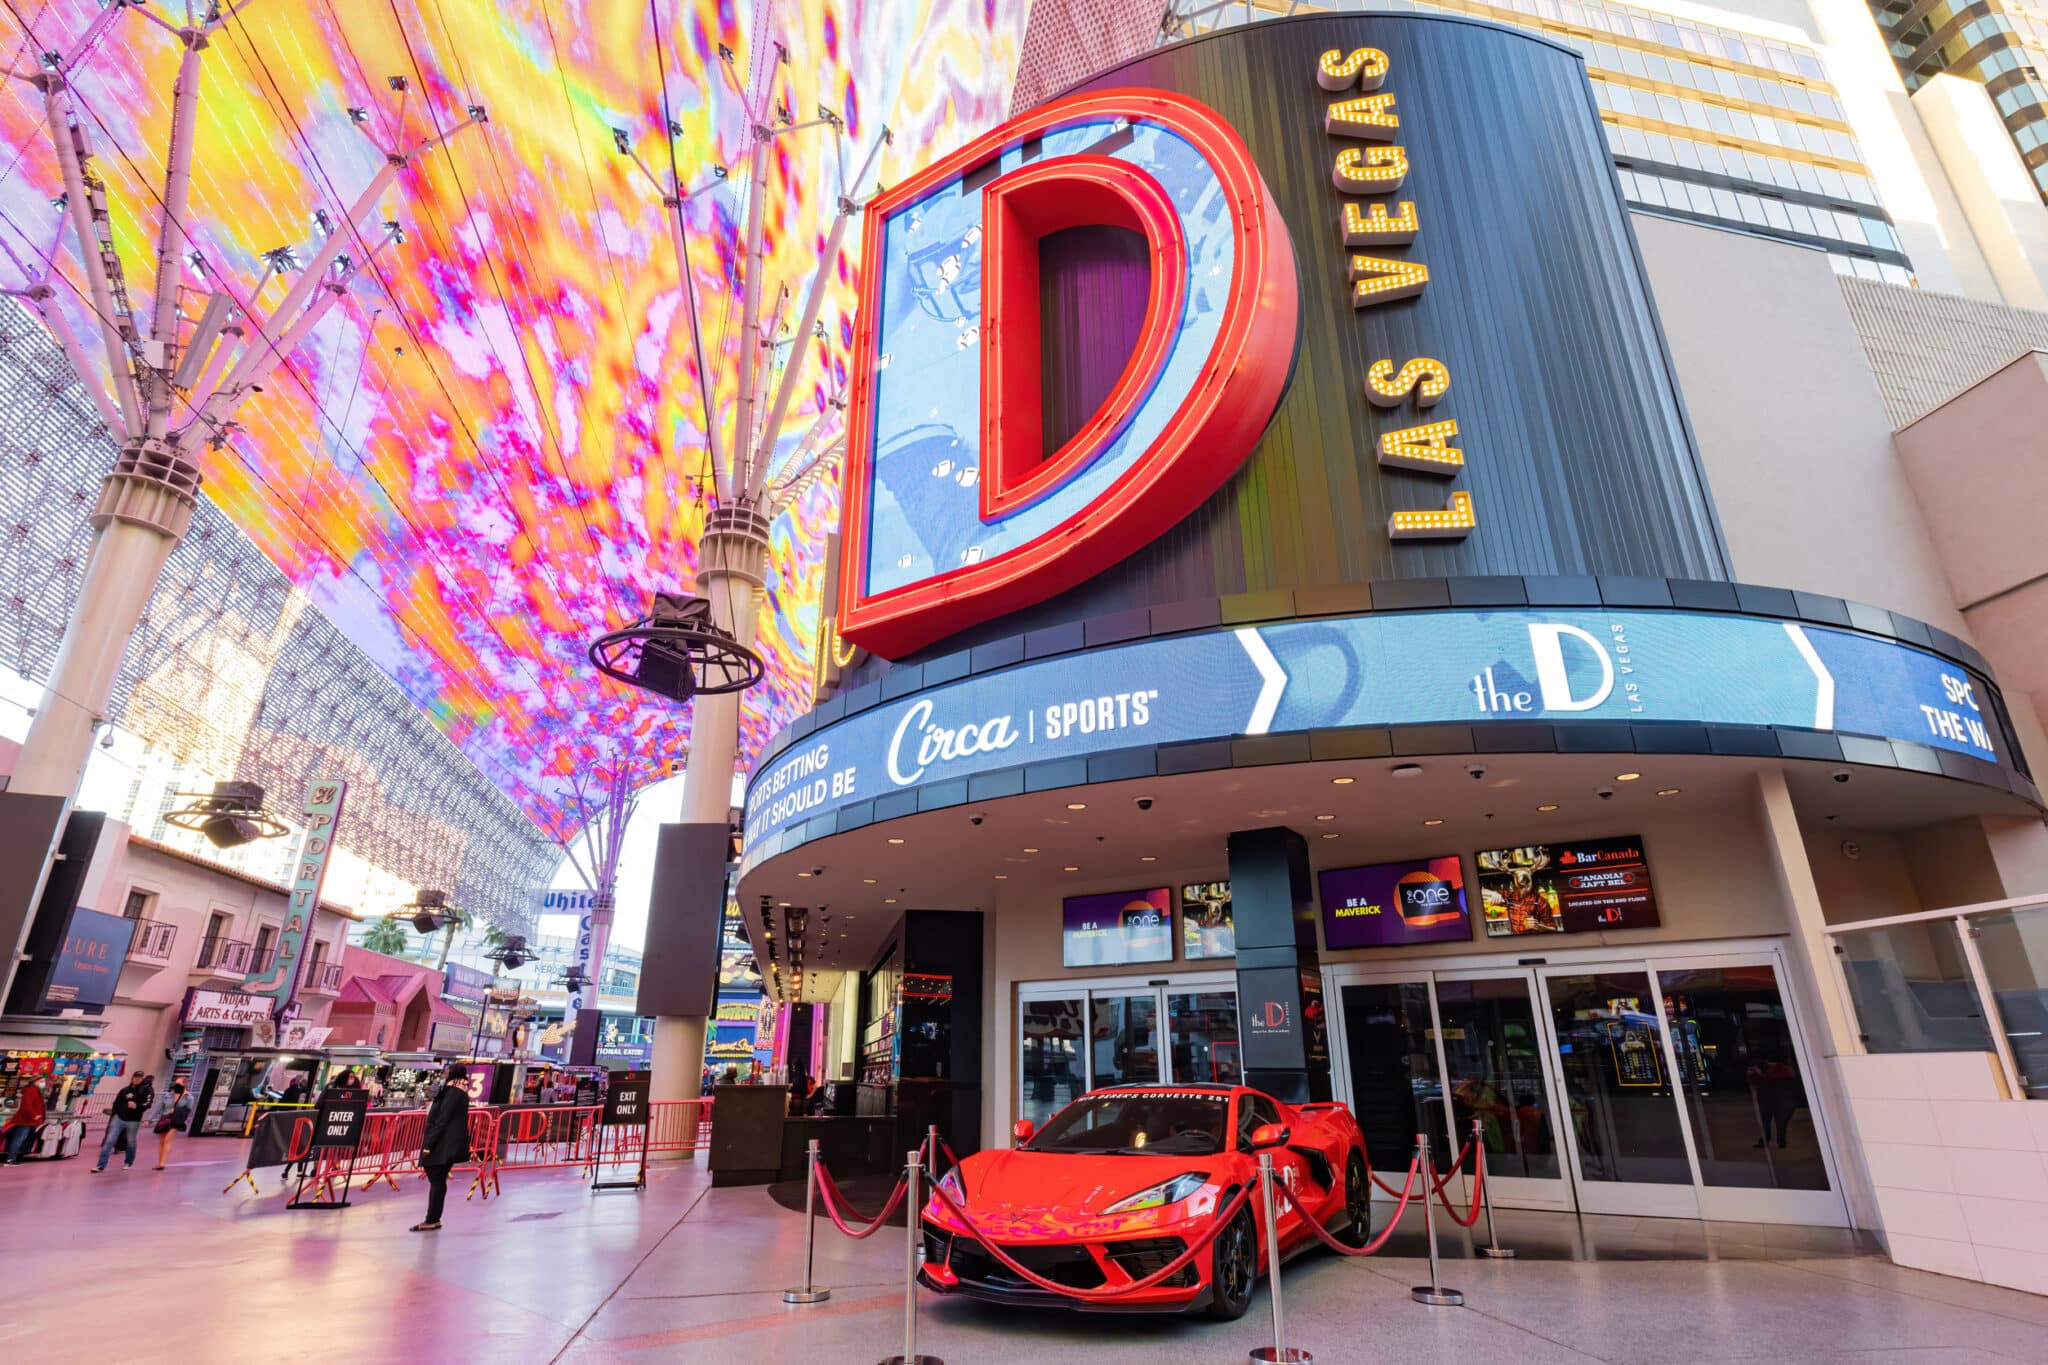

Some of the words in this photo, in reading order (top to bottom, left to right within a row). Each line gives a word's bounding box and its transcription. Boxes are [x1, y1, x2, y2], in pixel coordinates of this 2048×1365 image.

[1316, 47, 1428, 309] VEGAS
[840, 87, 1298, 664] D
[1365, 357, 1474, 540] LAS
[1611, 624, 1633, 675] VEGAS
[1473, 666, 1533, 712] the
[1528, 623, 1614, 711] D
[1626, 683, 1643, 713] LAS
[1920, 704, 1969, 743] THE
[887, 700, 1019, 785] Circa
[772, 744, 829, 795] BETTING
[310, 786, 337, 804] El
[762, 808, 771, 833] IT
[771, 779, 827, 826] SHOULD
[832, 767, 857, 798] BE
[1577, 848, 1639, 863] BarCanada
[279, 814, 331, 959] PORTAL
[1413, 887, 1450, 904] one
[1335, 905, 1381, 918] MAVERICK
[1346, 898, 1357, 907] BE
[1359, 897, 1367, 906] A
[1082, 922, 1091, 930] BE
[1132, 914, 1160, 928] one
[573, 915, 592, 1010] Caste
[218, 993, 250, 1008] INDIAN
[194, 1006, 221, 1021] ARTS
[222, 1009, 229, 1019] &
[231, 1009, 265, 1025] CRAFTS
[1251, 1014, 1265, 1027] the
[1265, 1002, 1285, 1027] D
[619, 1091, 637, 1102] EXIT
[328, 1111, 354, 1122] ENTER
[616, 1104, 637, 1116] ONLY
[327, 1125, 350, 1137] ONLY
